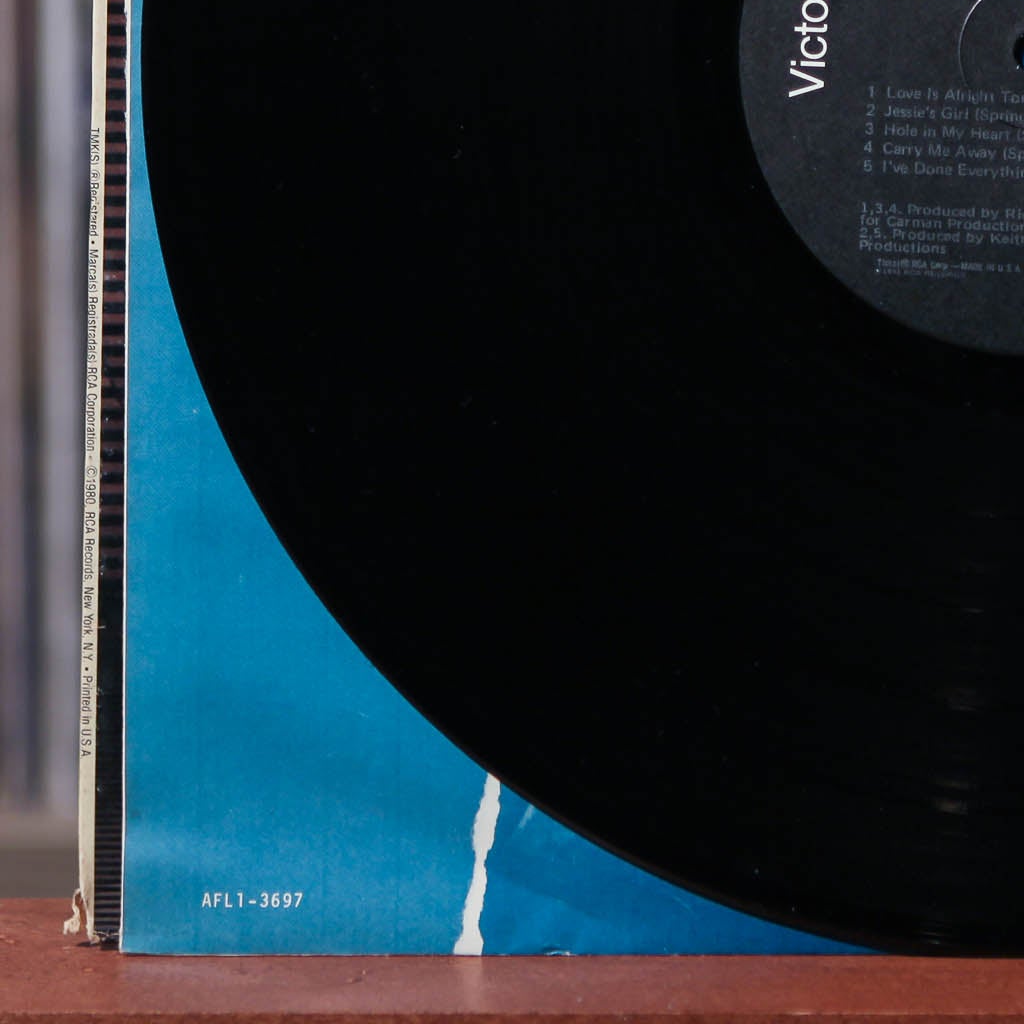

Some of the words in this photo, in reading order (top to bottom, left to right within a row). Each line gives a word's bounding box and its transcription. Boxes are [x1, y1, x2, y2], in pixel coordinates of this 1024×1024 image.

[868, 86, 875, 98] 1
[887, 86, 921, 100] Love
[944, 89, 995, 105] Alright
[866, 105, 876, 117] 2
[884, 105, 936, 119] Jessie's
[941, 107, 969, 120] Girl
[865, 123, 874, 136] 3
[884, 124, 918, 138] Hole
[923, 125, 936, 138] in
[942, 126, 965, 142] My
[971, 128, 1010, 142] Heart
[863, 140, 873, 153] 4
[882, 141, 921, 157] Carry
[928, 144, 950, 157] Me
[955, 145, 997, 160] Away
[863, 160, 873, 173] 5
[881, 159, 908, 173] I've
[914, 161, 953, 176] Done
[907, 203, 976, 218] Produced
[981, 206, 999, 221] by
[860, 214, 881, 227] for
[886, 216, 942, 229] Carman
[893, 228, 960, 243] Produced
[966, 231, 984, 246] by
[859, 240, 947, 255] Productions
[86, 367, 98, 389] RCA
[85, 393, 98, 452] Corporation
[84, 512, 96, 534] RCA
[82, 587, 95, 609] New
[80, 676, 94, 712] Printed
[80, 716, 93, 725] in
[201, 892, 304, 909] AFL1-3697
